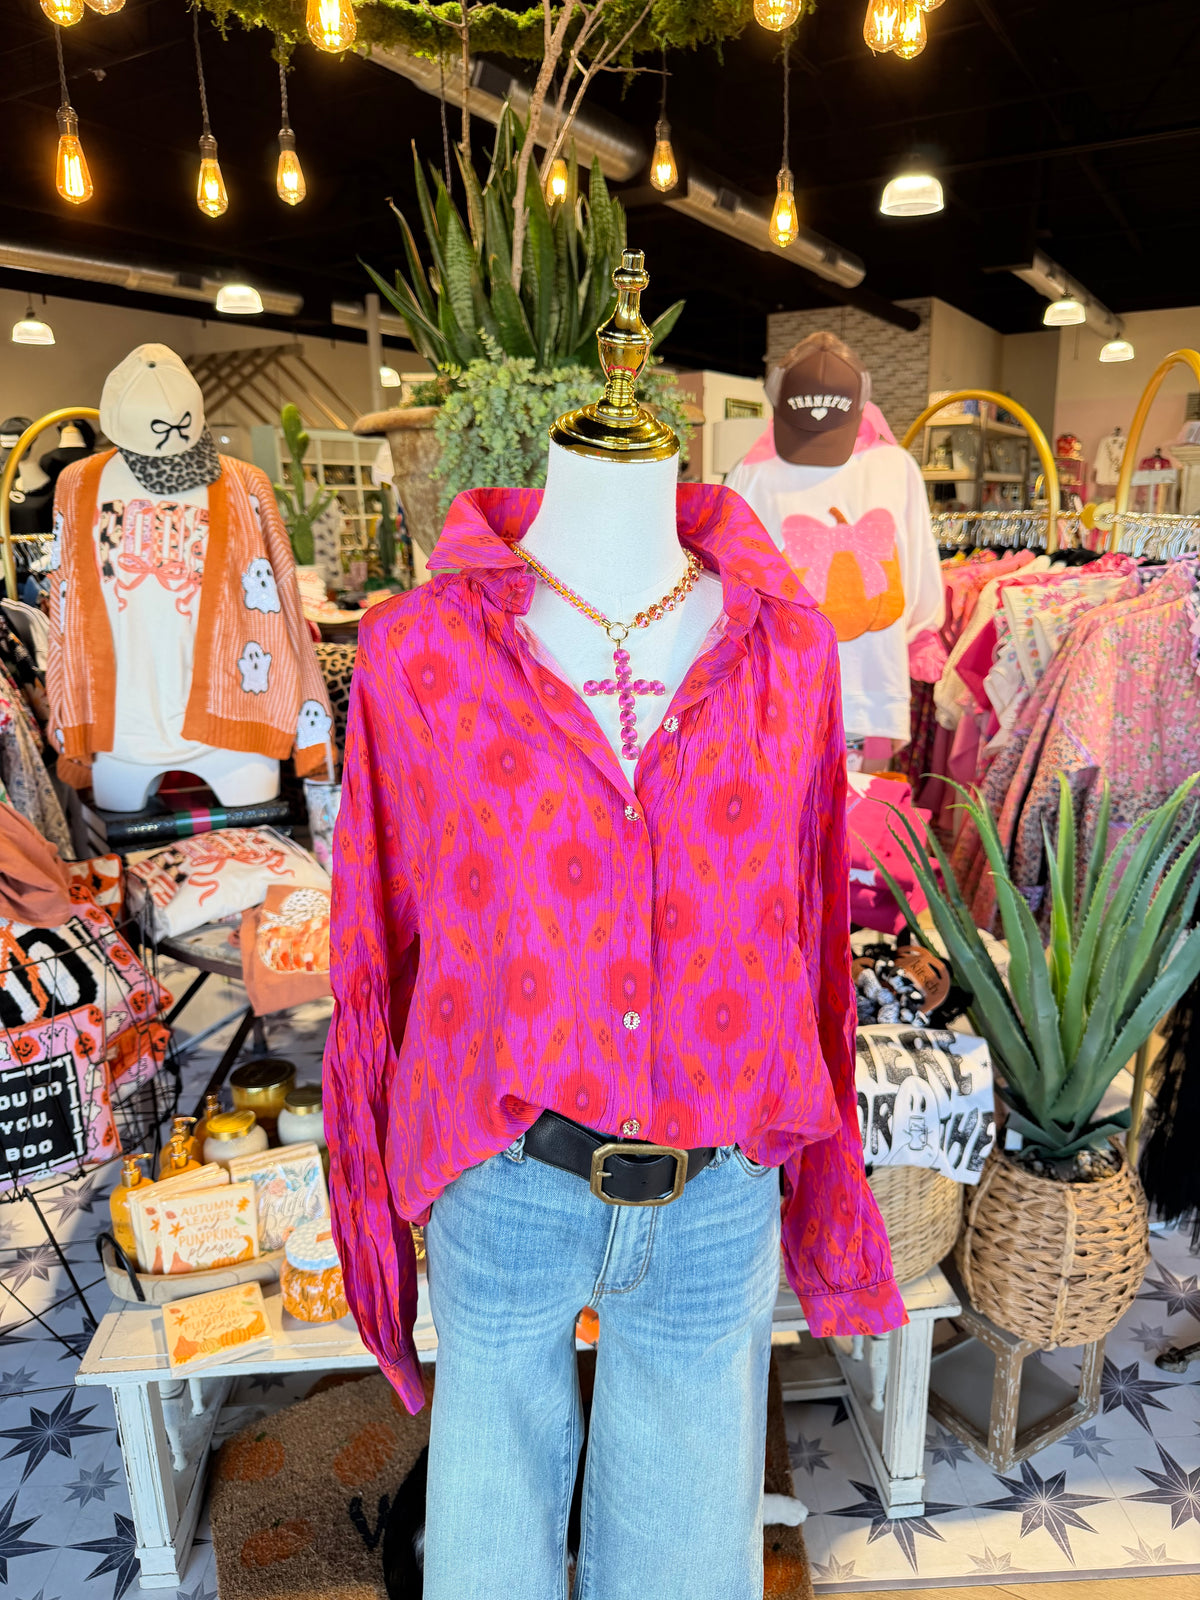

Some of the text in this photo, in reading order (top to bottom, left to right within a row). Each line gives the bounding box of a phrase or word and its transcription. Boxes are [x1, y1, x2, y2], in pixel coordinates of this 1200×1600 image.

[787, 394, 853, 412] THANKFUL
[0, 1081, 63, 1112] OU DO
[0, 1111, 54, 1135] YOU,
[5, 1139, 53, 1162] BOO
[181, 1199, 235, 1217] AUTUMN
[186, 1210, 231, 1227] LEAVES
[197, 1217, 220, 1231] and
[179, 1225, 241, 1247] PUMPKINS
[187, 1240, 234, 1261] please
